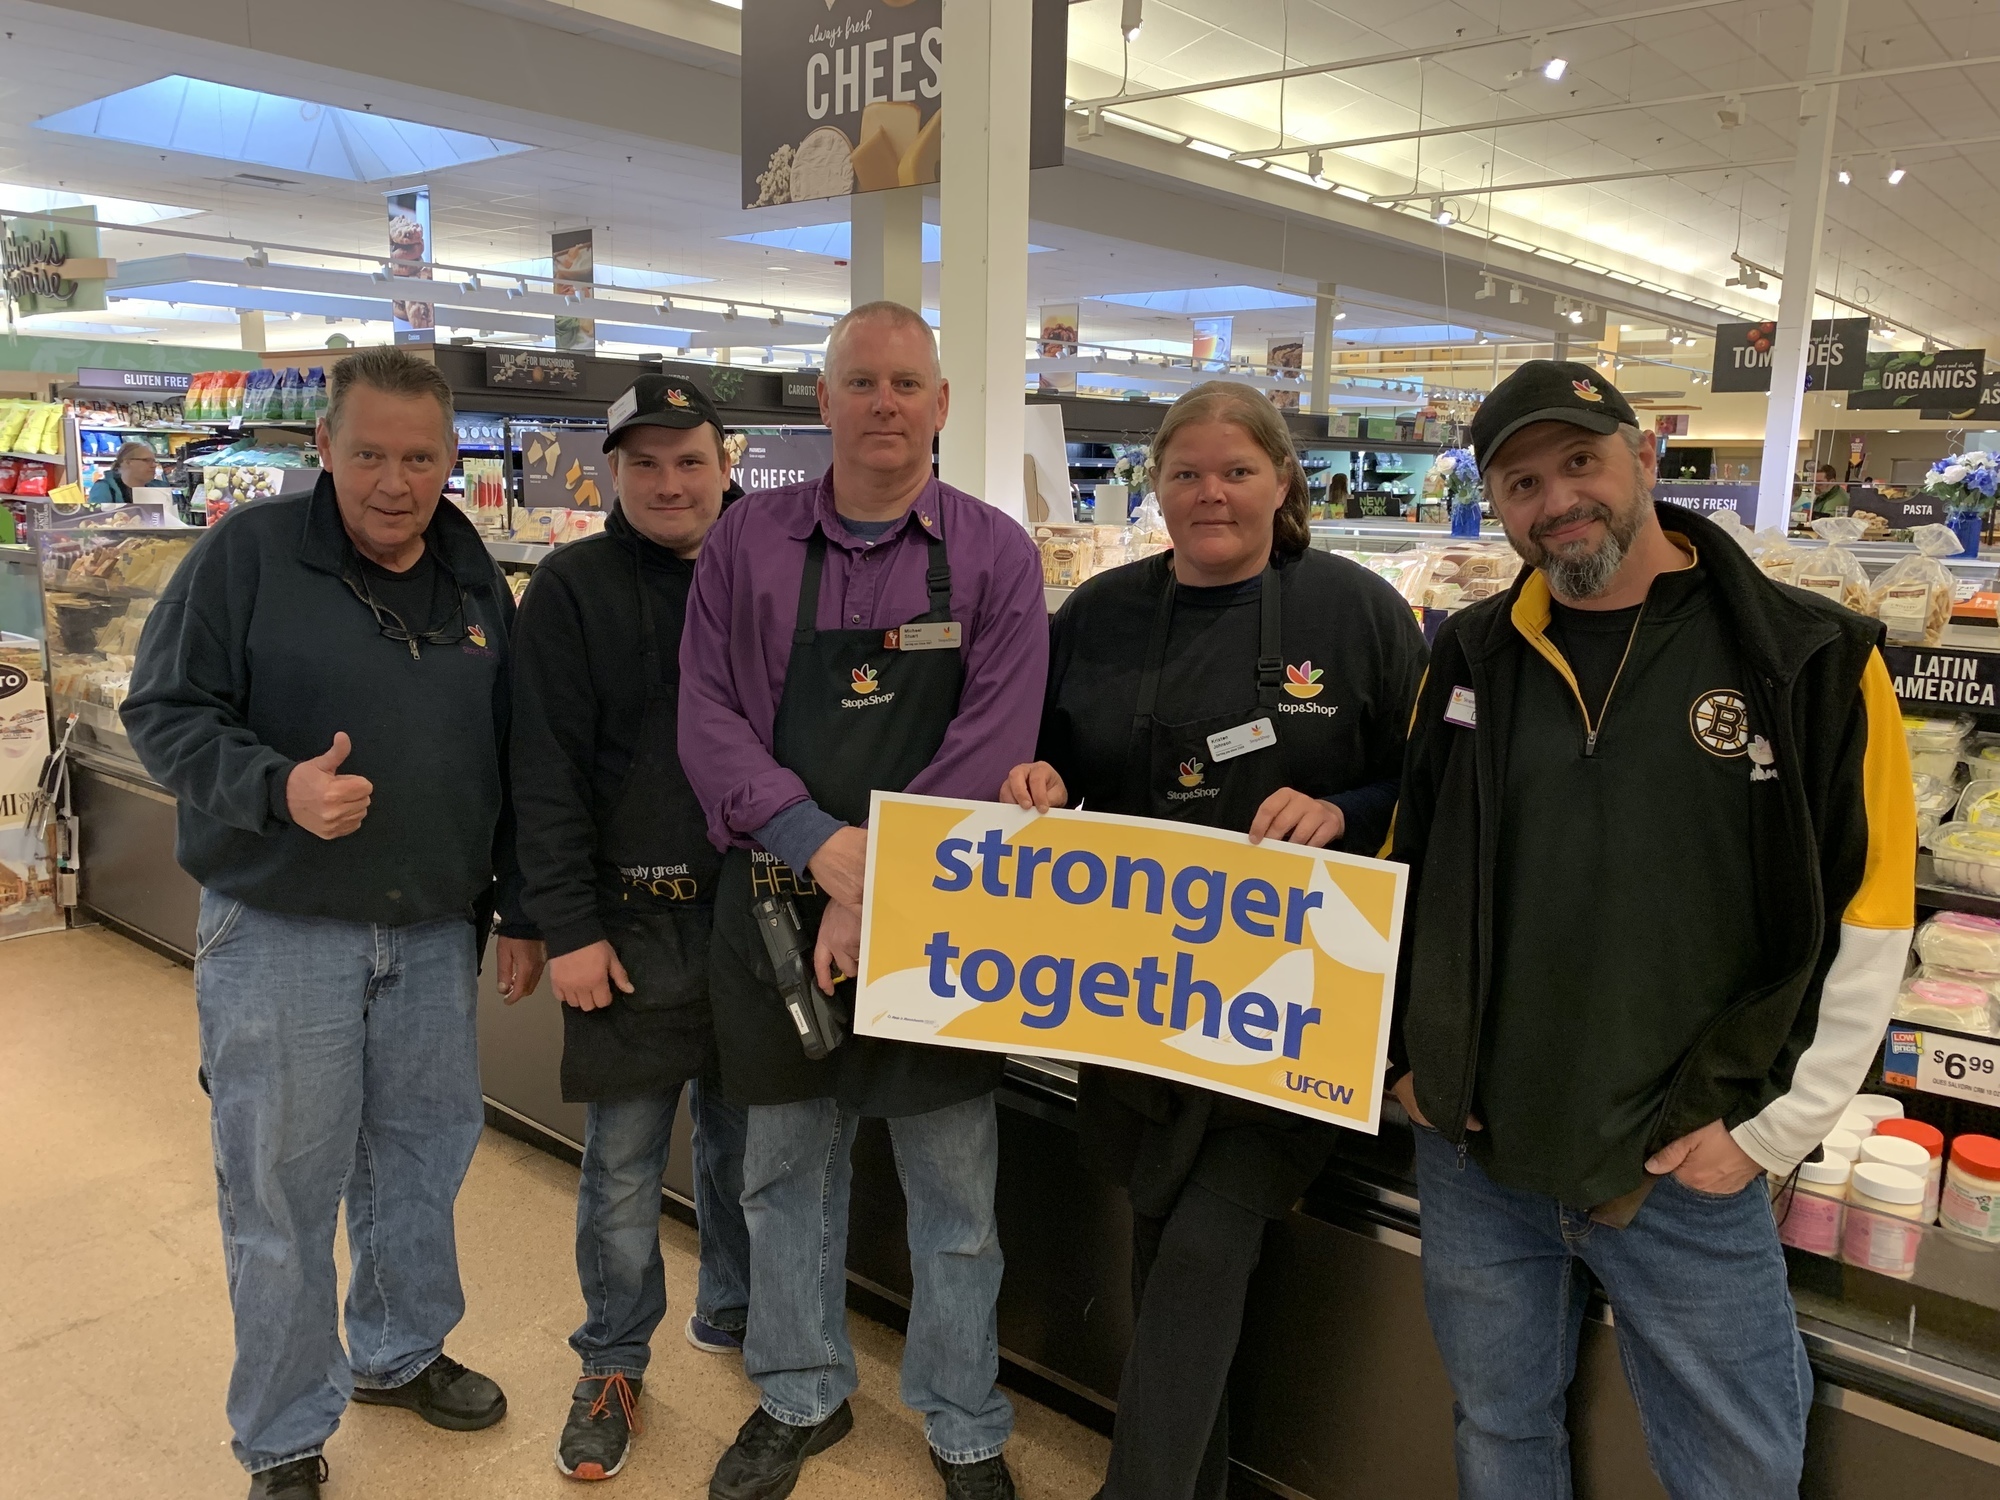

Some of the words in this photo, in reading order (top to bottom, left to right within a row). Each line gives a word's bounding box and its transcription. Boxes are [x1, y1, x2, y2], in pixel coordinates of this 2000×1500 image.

[809, 24, 843, 48] always
[845, 9, 873, 39] fresh
[806, 26, 942, 120] CHEES
[499, 353, 515, 364] WILD
[526, 356, 538, 366] FOR
[539, 357, 575, 369] MUSHROOMS
[124, 374, 161, 387] GLUTEN
[164, 376, 189, 388] FREE
[1882, 369, 1978, 390] ORGANICS
[788, 384, 816, 396] CARROTS
[751, 468, 806, 489] CHEESE
[1359, 494, 1387, 506] NEW
[1703, 498, 1738, 511] FRESH
[1361, 506, 1387, 516] YORK
[1903, 504, 1933, 515] PASTA
[1914, 654, 1978, 680] LATIN
[1893, 676, 1995, 706] AMERICA
[1278, 702, 1338, 718] top&Shop
[652, 863, 690, 879] great
[932, 828, 1324, 945] stronger
[924, 930, 1322, 1060] together
[1893, 1033, 1915, 1042] LOW
[1286, 1071, 1354, 1105] UFCW
